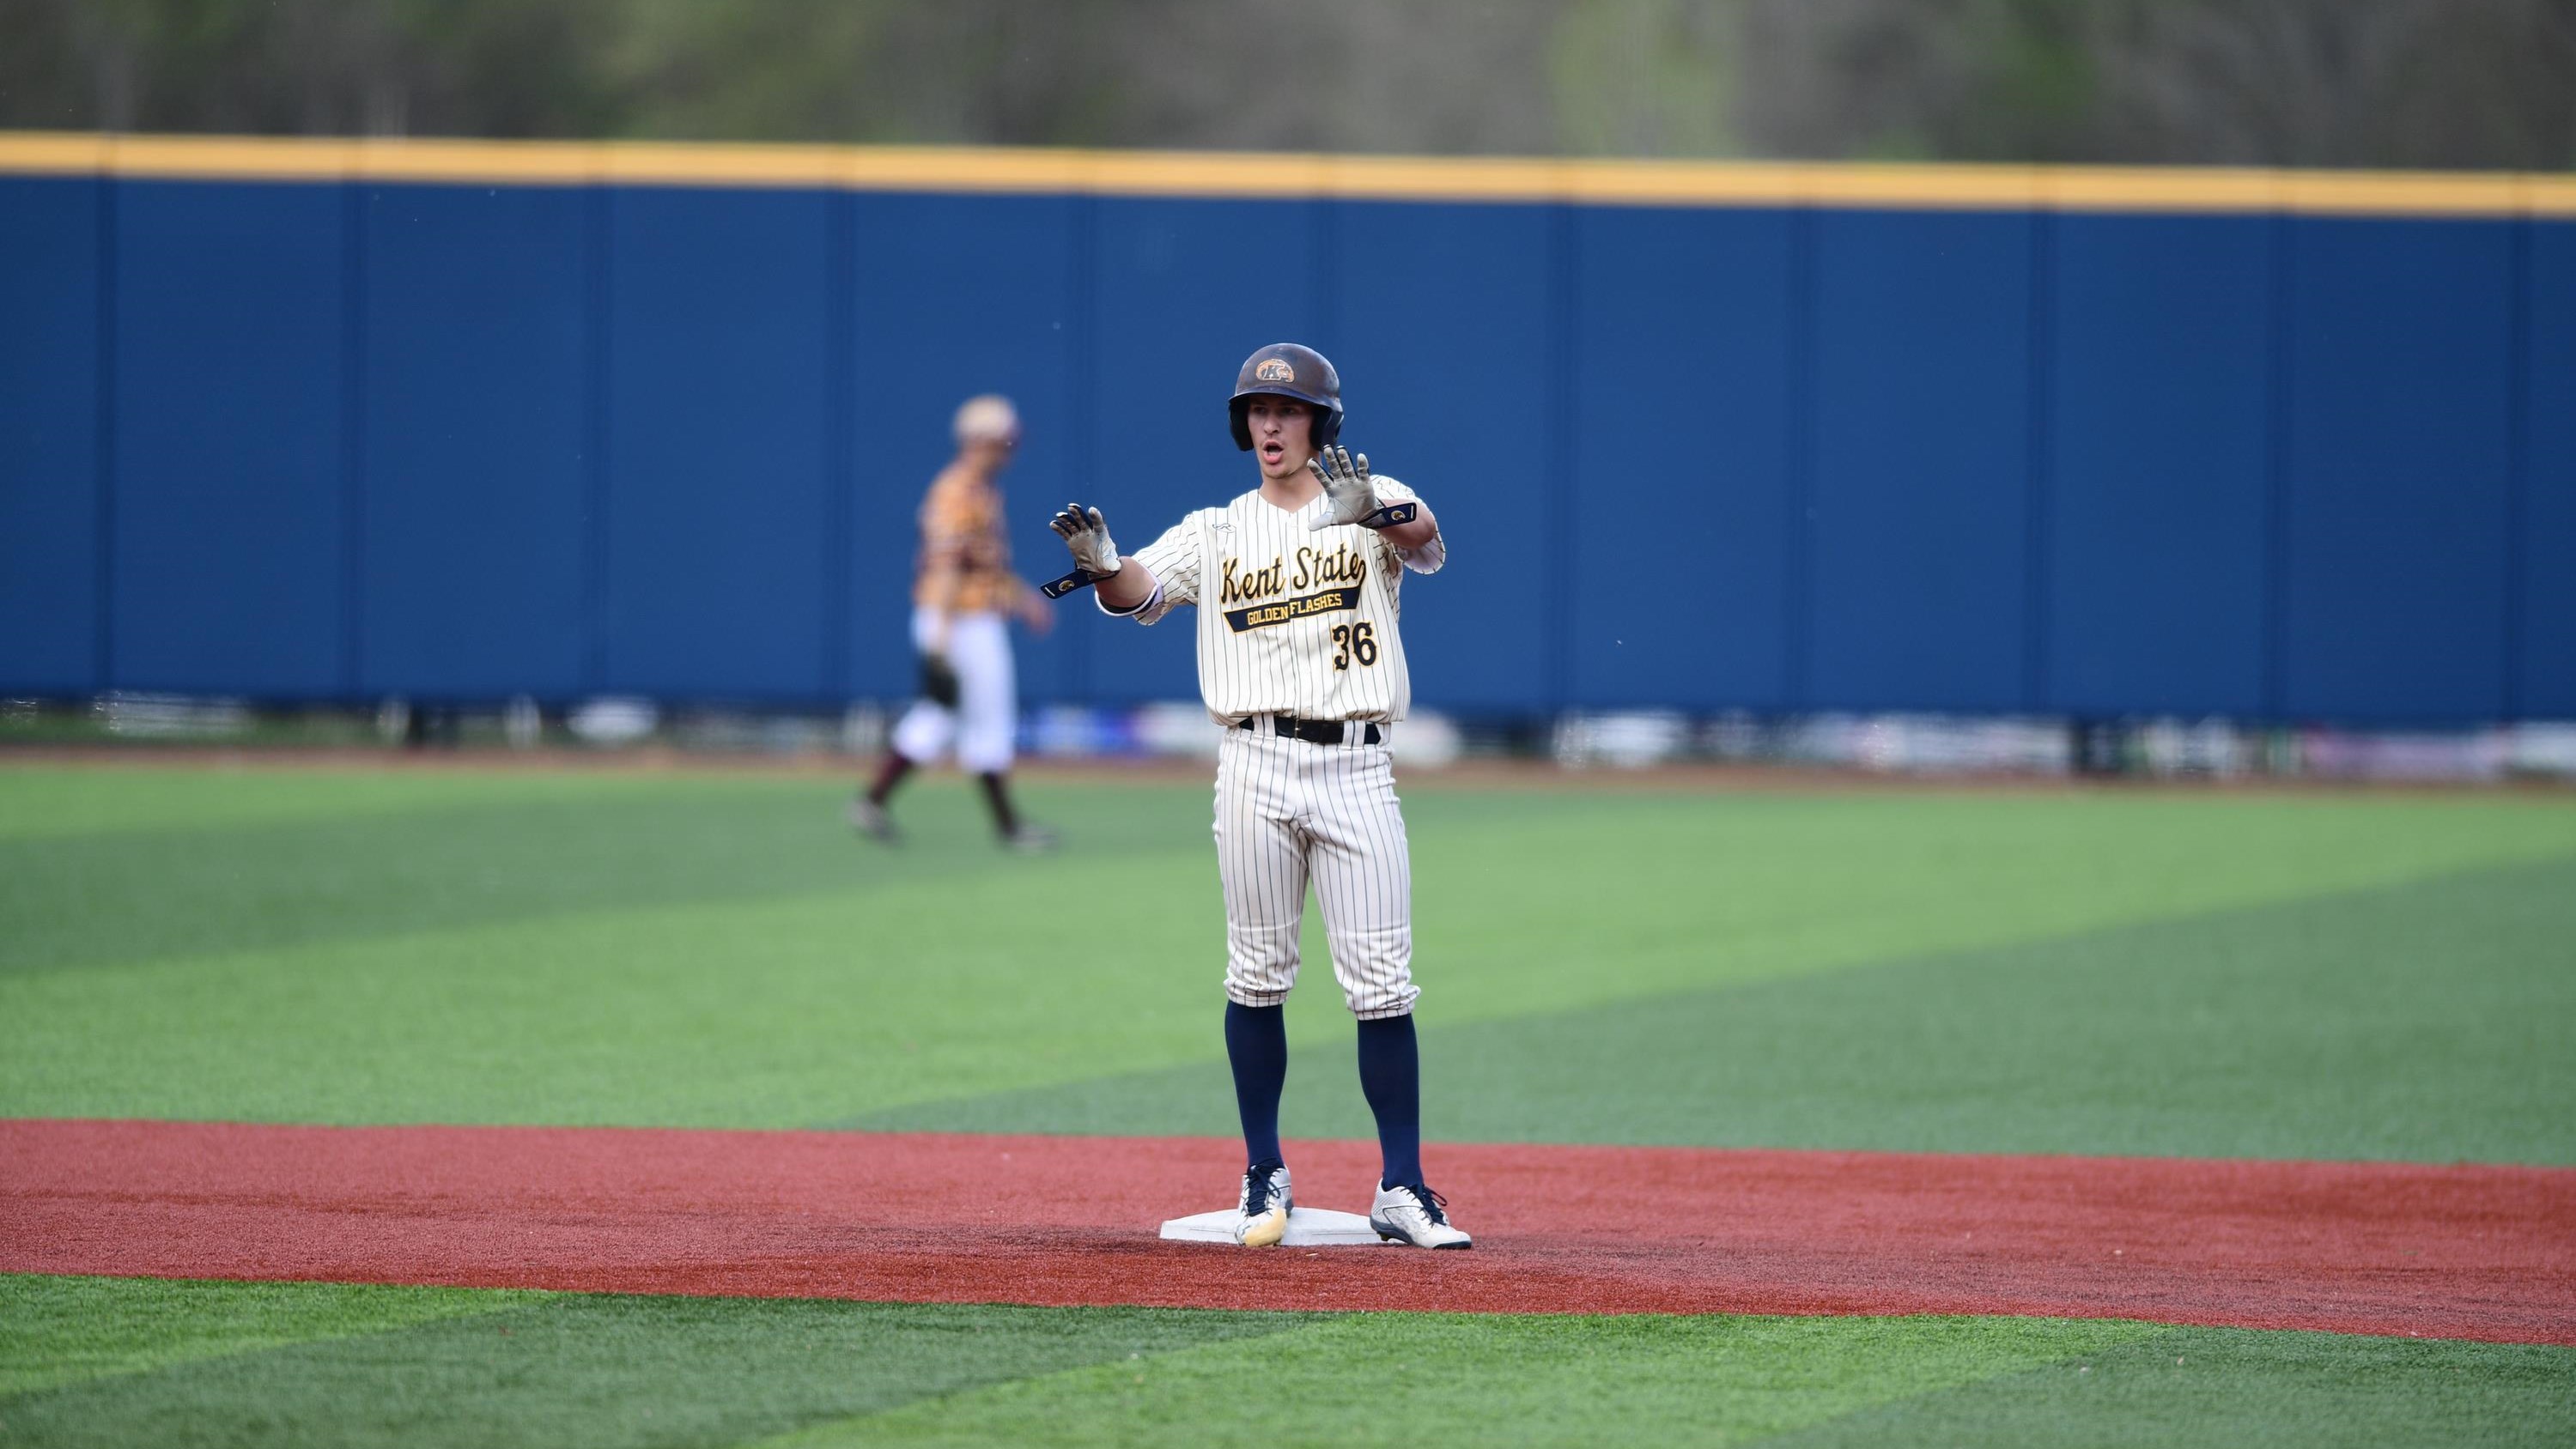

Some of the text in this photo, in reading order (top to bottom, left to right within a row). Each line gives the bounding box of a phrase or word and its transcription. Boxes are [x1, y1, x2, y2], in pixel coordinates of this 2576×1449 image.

[1220, 542, 1366, 604] Kent State
[1247, 592, 1343, 626] GOLDEN FLASHES
[1332, 621, 1377, 671] 36
